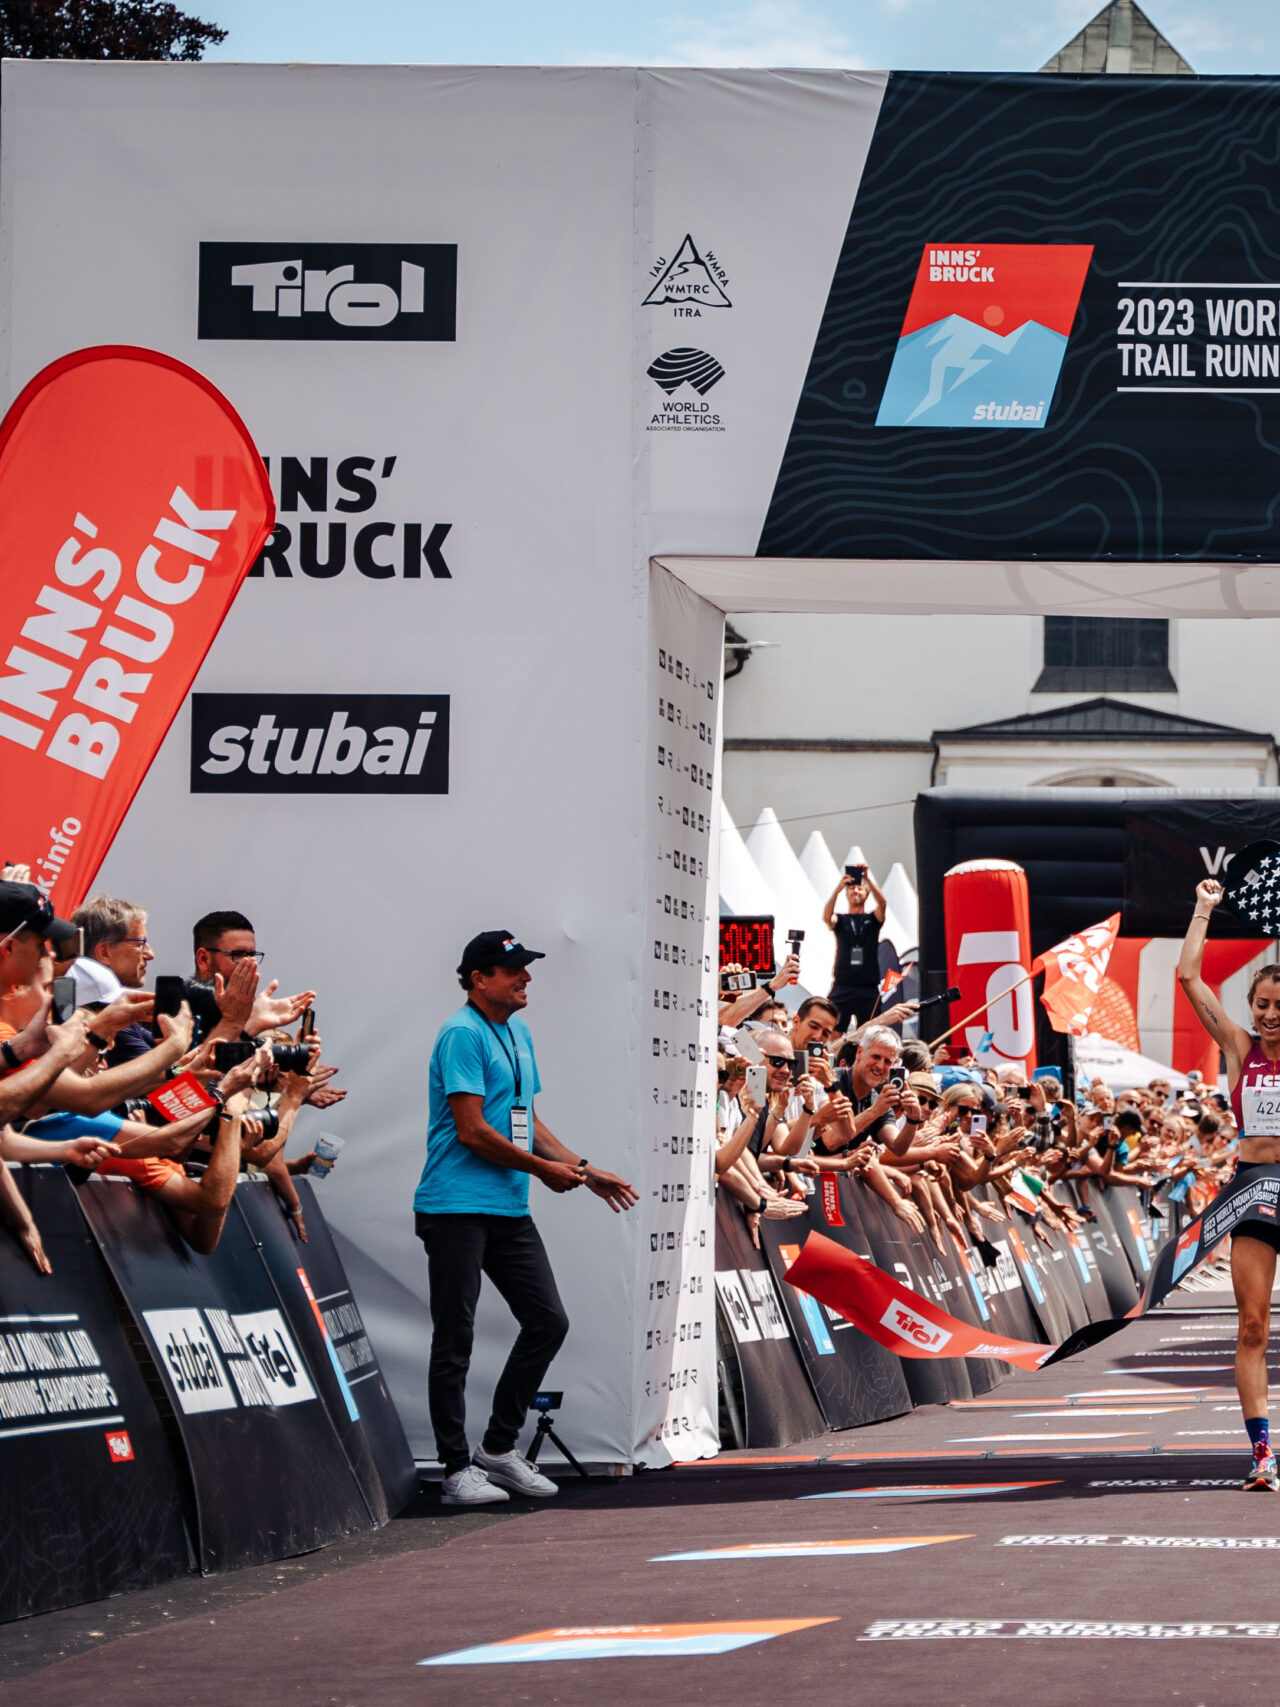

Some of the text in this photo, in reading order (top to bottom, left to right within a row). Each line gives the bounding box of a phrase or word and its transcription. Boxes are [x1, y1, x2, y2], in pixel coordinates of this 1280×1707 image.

[649, 256, 667, 278] IAU
[704, 250, 730, 288] WMRA
[929, 250, 981, 266] INNS'
[929, 266, 995, 283] BRUCK
[231, 259, 425, 327] Tirol
[663, 284, 710, 295] WMTRC
[674, 307, 702, 318] ITRA
[1117, 297, 1195, 336] 2023
[1117, 343, 1196, 377] TRAIL
[651, 413, 721, 425] ATHLETICS
[662, 402, 710, 413] WORLD
[972, 400, 1045, 422] stubai
[46, 484, 238, 781] BRUCK
[200, 709, 439, 777] stubai
[36, 815, 83, 897] k.info
[1263, 1181, 1280, 1193] AND
[894, 1308, 942, 1346] Tirol
[67, 1328, 102, 1367] AND
[165, 1326, 224, 1393] stubai
[245, 1328, 298, 1389] Tirol
